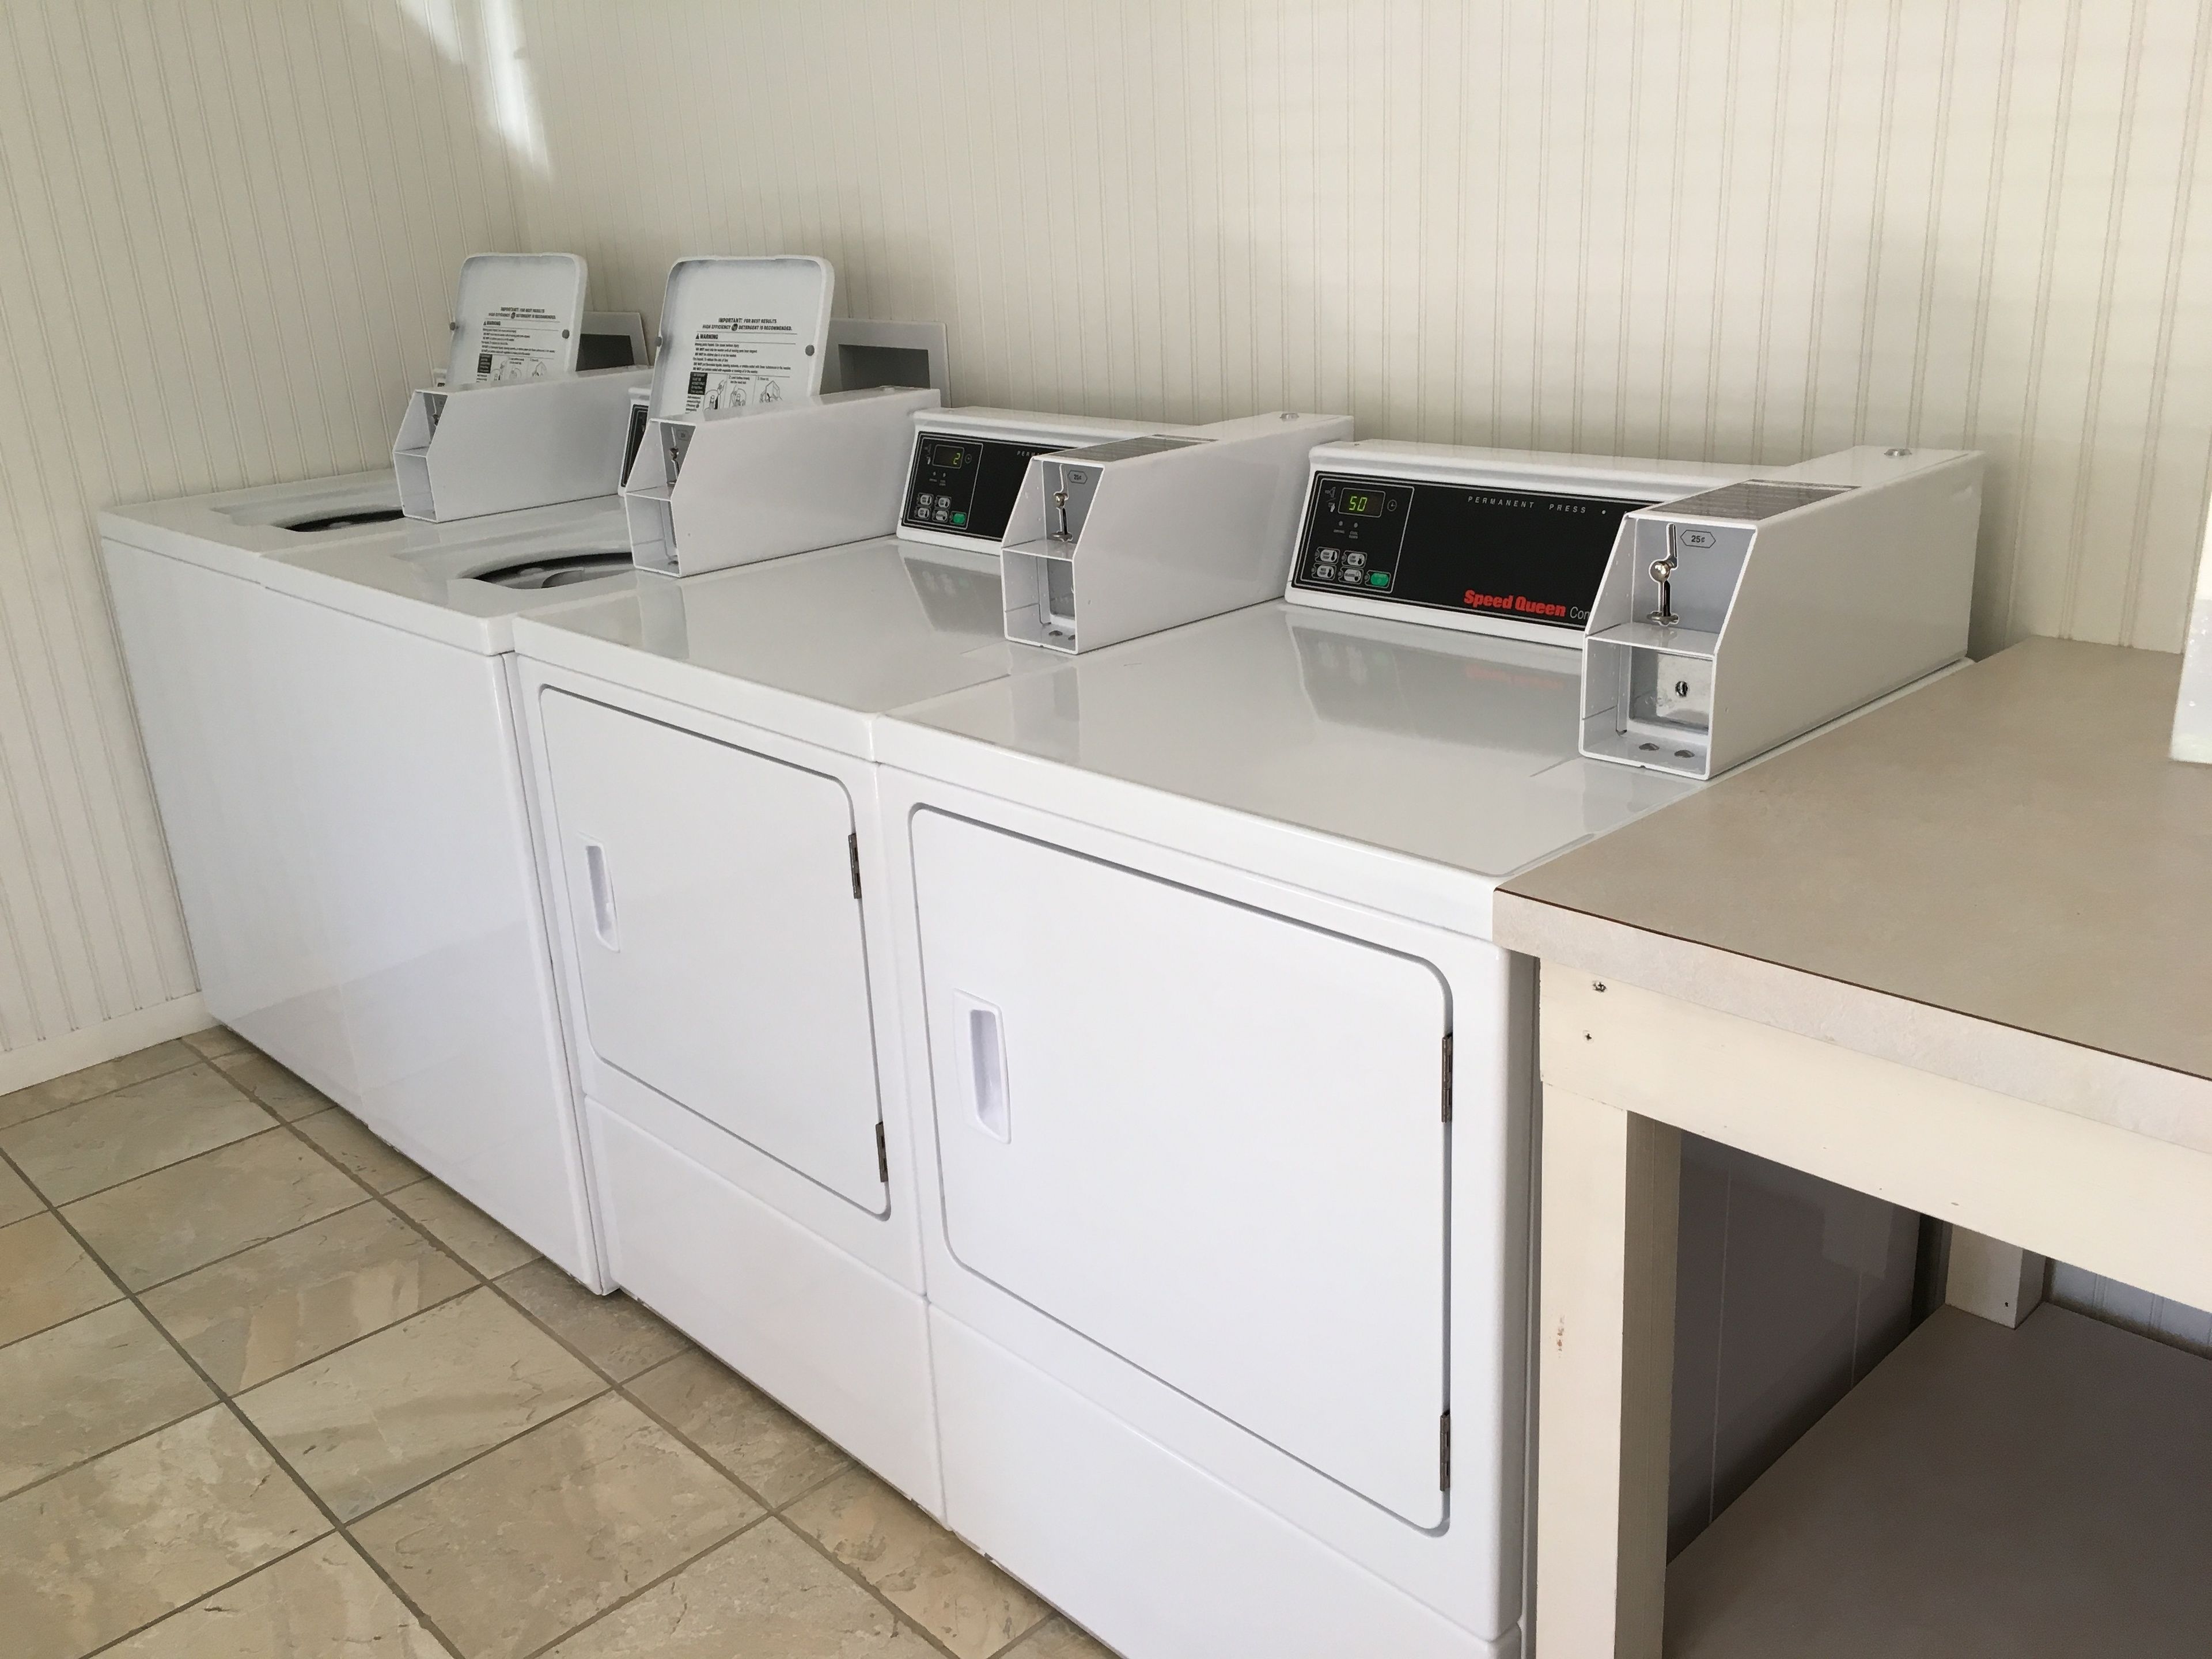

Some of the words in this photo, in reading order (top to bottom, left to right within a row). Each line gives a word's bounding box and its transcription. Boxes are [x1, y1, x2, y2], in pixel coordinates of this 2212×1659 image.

[953, 453, 960, 464] 2
[1349, 496, 1368, 512] 50
[1468, 496, 1535, 508] PERMANENT
[1549, 504, 1586, 514] PRESS
[1464, 589, 1514, 609] Speed
[1514, 596, 1567, 617] Queen
